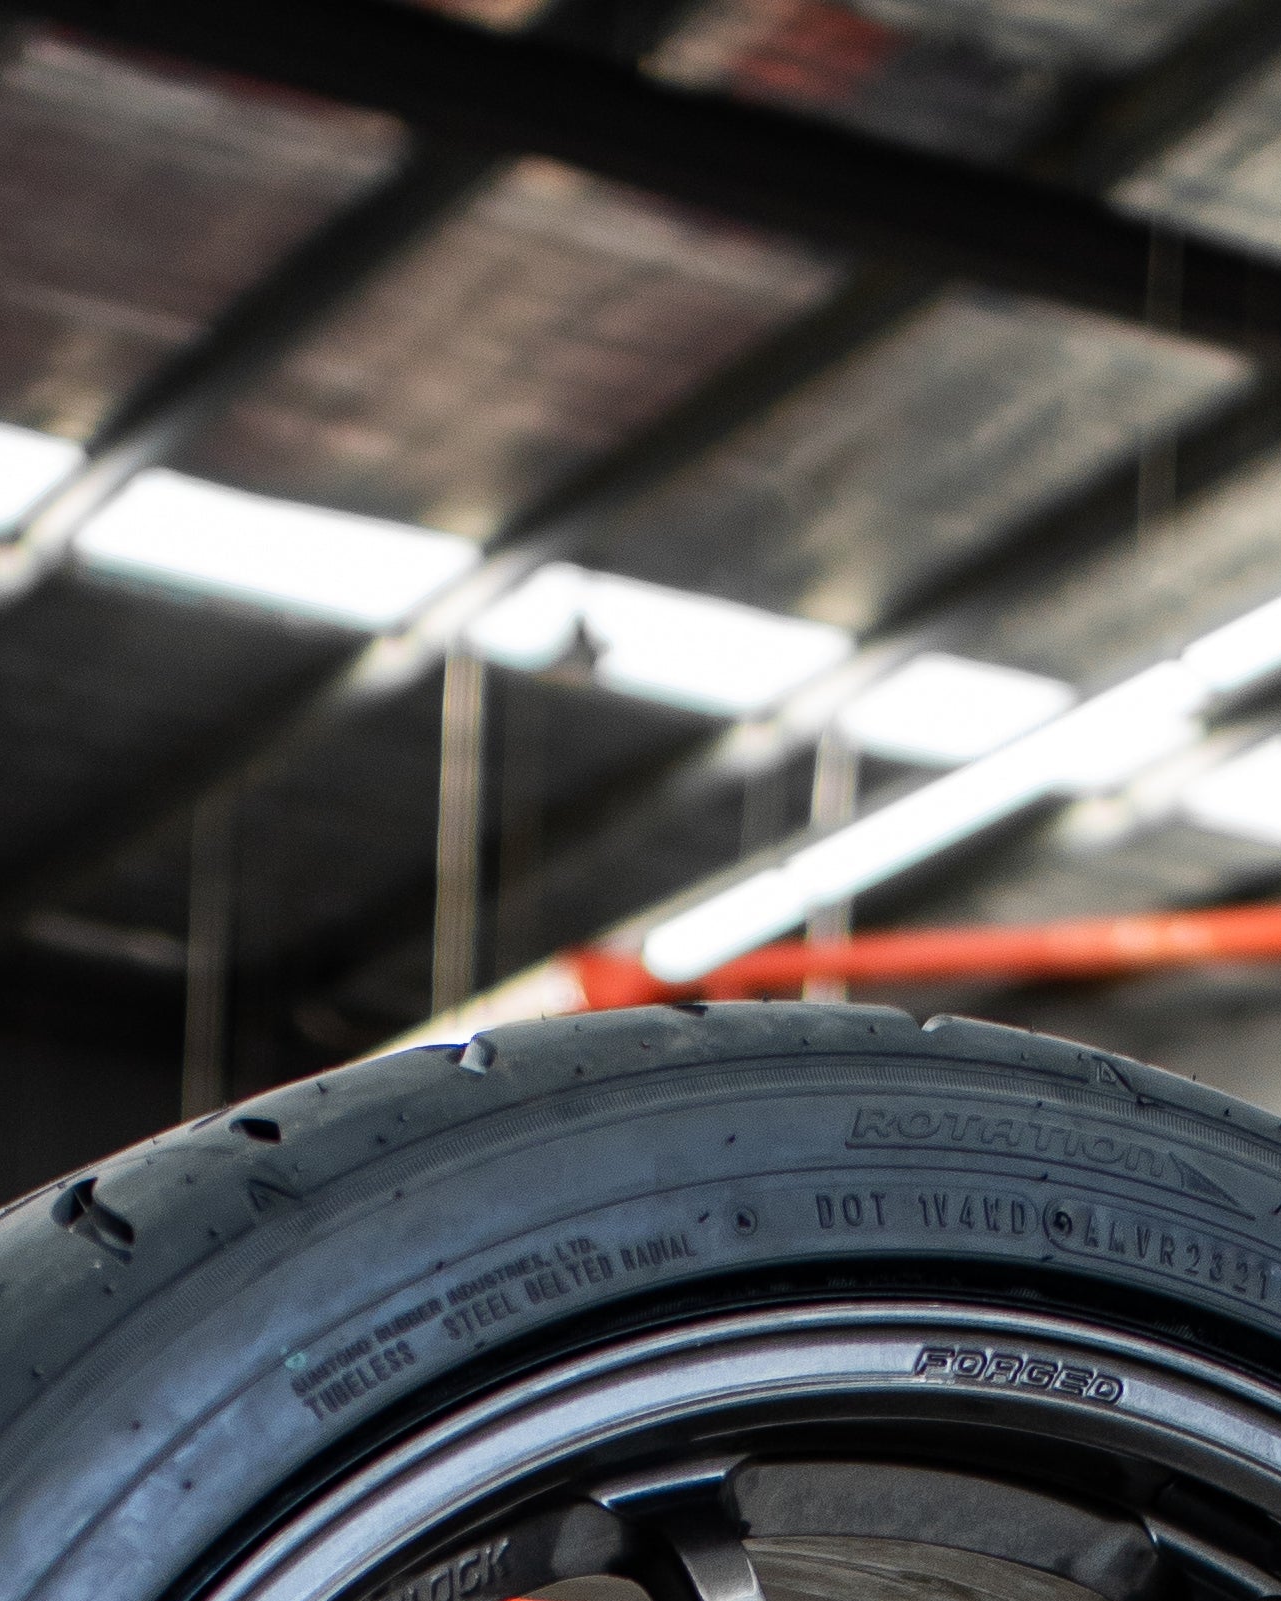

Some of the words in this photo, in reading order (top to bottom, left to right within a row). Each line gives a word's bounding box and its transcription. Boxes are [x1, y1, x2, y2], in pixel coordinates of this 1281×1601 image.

[850, 1106, 1166, 1179] ROTATION
[815, 1191, 885, 1228] DOT
[303, 1335, 417, 1424] TUBELESS
[441, 1284, 520, 1343] STEEL
[522, 1249, 616, 1308] BELTED
[619, 1227, 697, 1273] RADIAL
[912, 1346, 1125, 1403] FORGED
